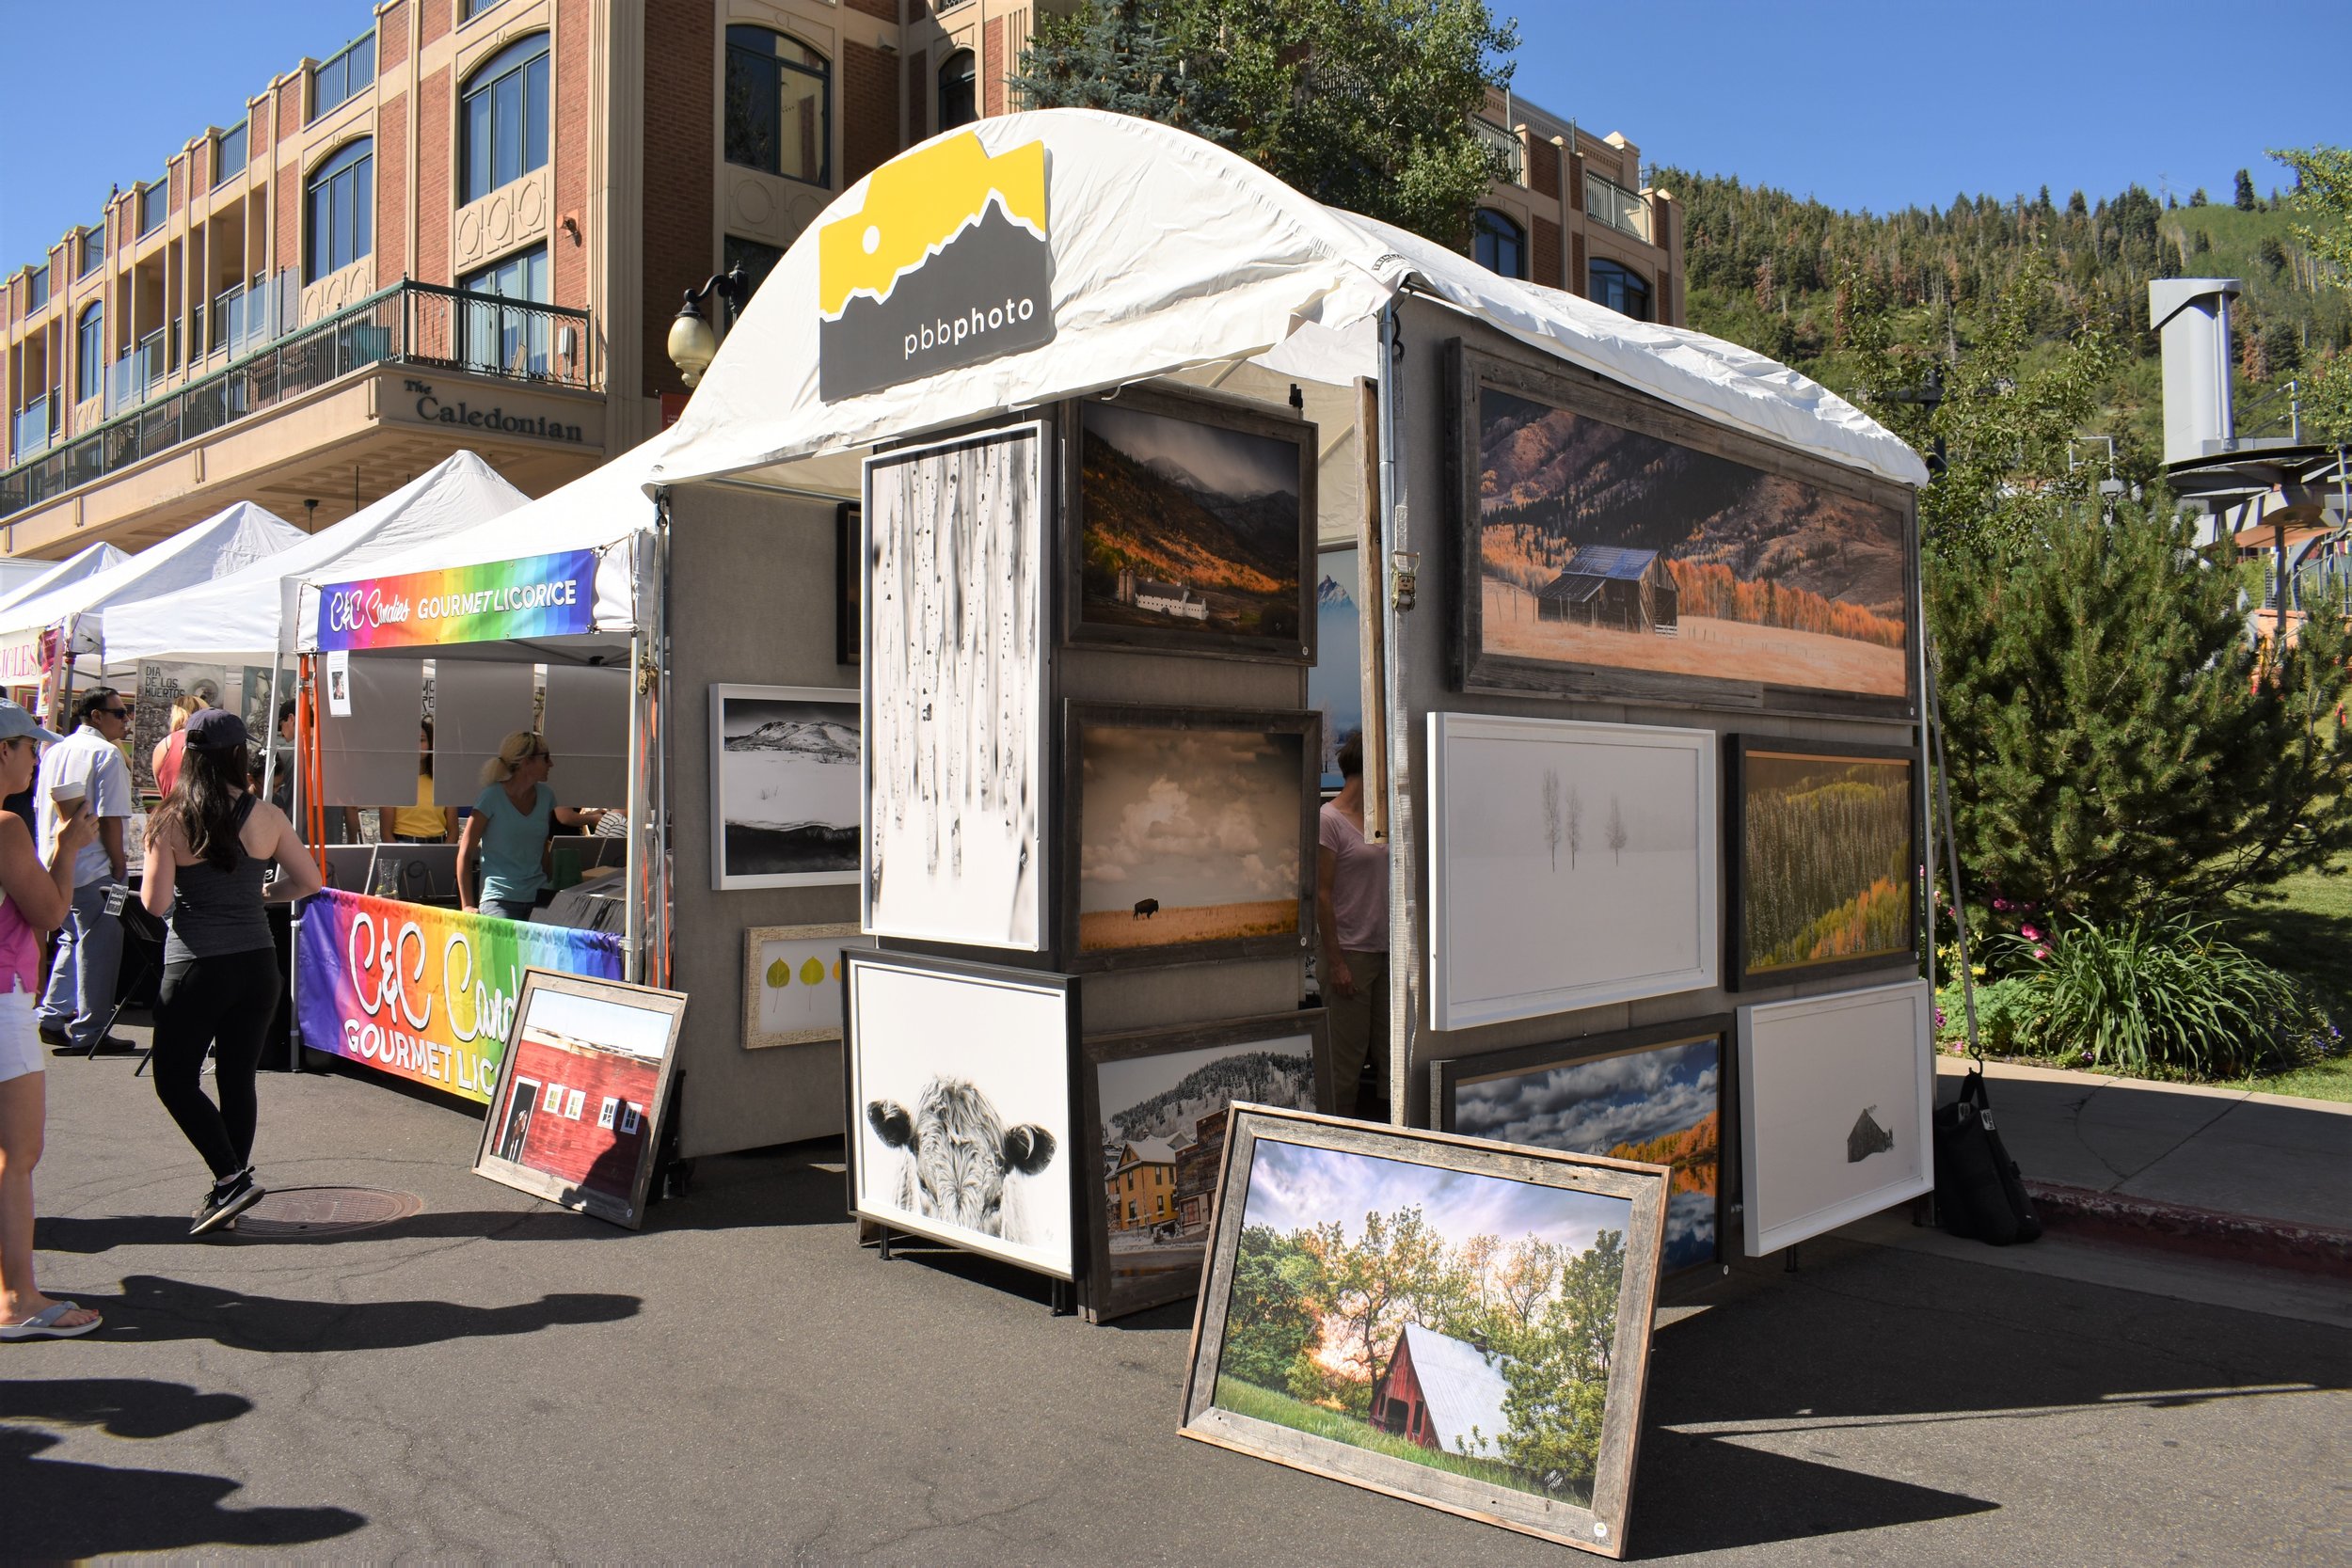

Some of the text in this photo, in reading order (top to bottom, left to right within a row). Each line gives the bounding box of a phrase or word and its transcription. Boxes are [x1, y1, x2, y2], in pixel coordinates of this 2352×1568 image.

[904, 298, 1034, 360] pbbphoto
[404, 379, 432, 395] The
[416, 396, 583, 442] Caledonian
[330, 579, 577, 632] C&C Candies GOURMET LICORICE
[145, 677, 179, 689] DE LOS
[145, 688, 186, 699] MUERTOS
[146, 666, 161, 676] DIA
[349, 911, 432, 1030] C&C
[344, 1018, 501, 1097] GOURMET LIC
